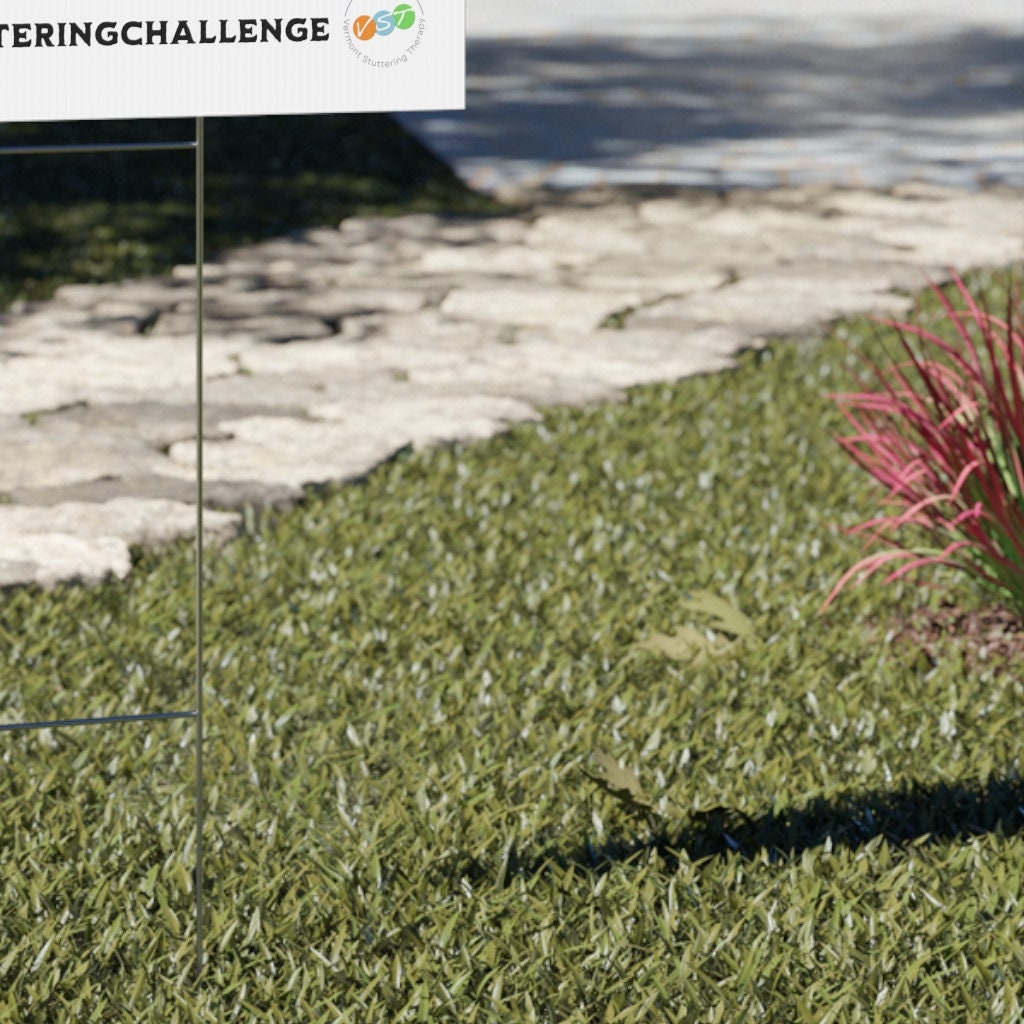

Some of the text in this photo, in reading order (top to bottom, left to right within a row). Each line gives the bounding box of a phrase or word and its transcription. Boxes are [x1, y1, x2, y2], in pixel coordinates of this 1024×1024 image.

[343, 17, 426, 68] Vermont Stuttering Therapy
[355, 6, 415, 38] VST
